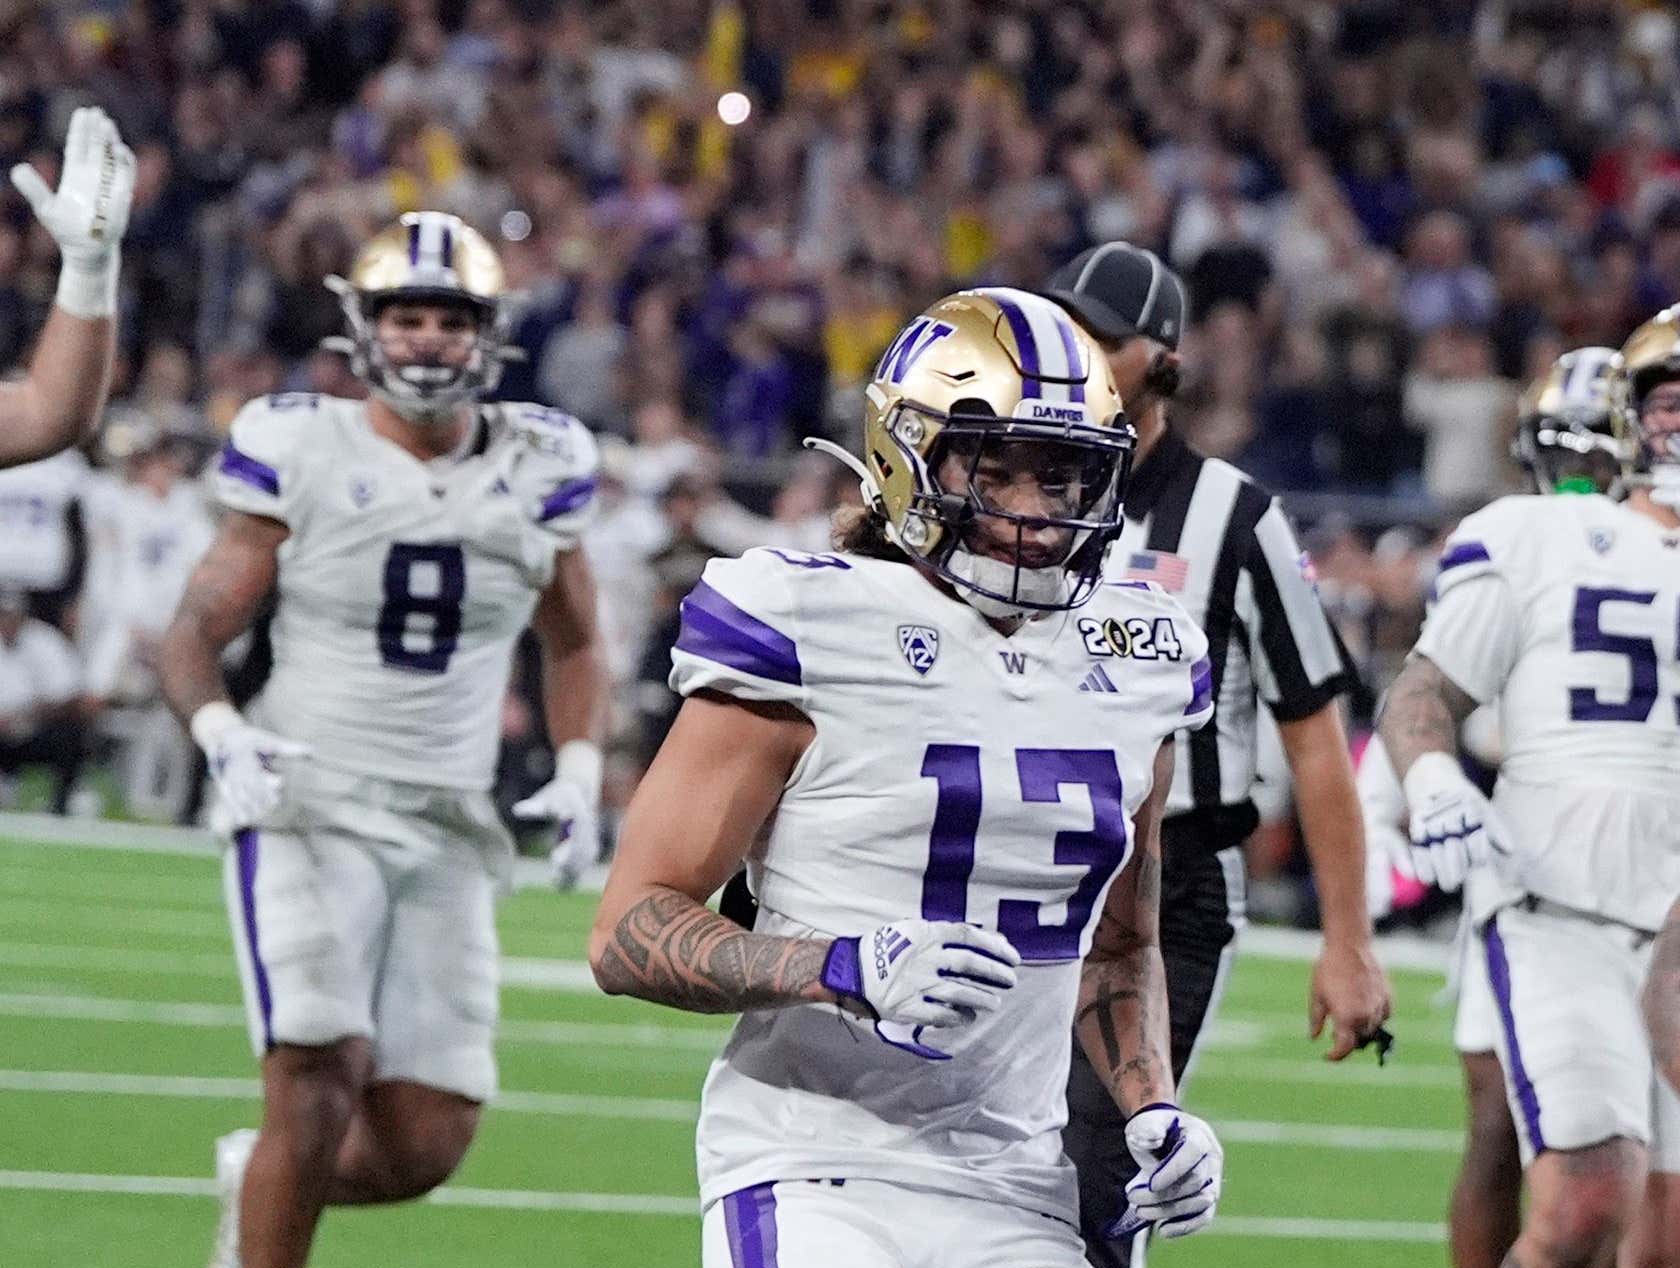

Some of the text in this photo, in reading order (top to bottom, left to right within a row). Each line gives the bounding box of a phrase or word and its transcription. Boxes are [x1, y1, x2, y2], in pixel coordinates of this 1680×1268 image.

[376, 542, 465, 674] 8
[1078, 618, 1182, 661] 2024
[1000, 651, 1027, 675] W
[921, 744, 1126, 960] 13
